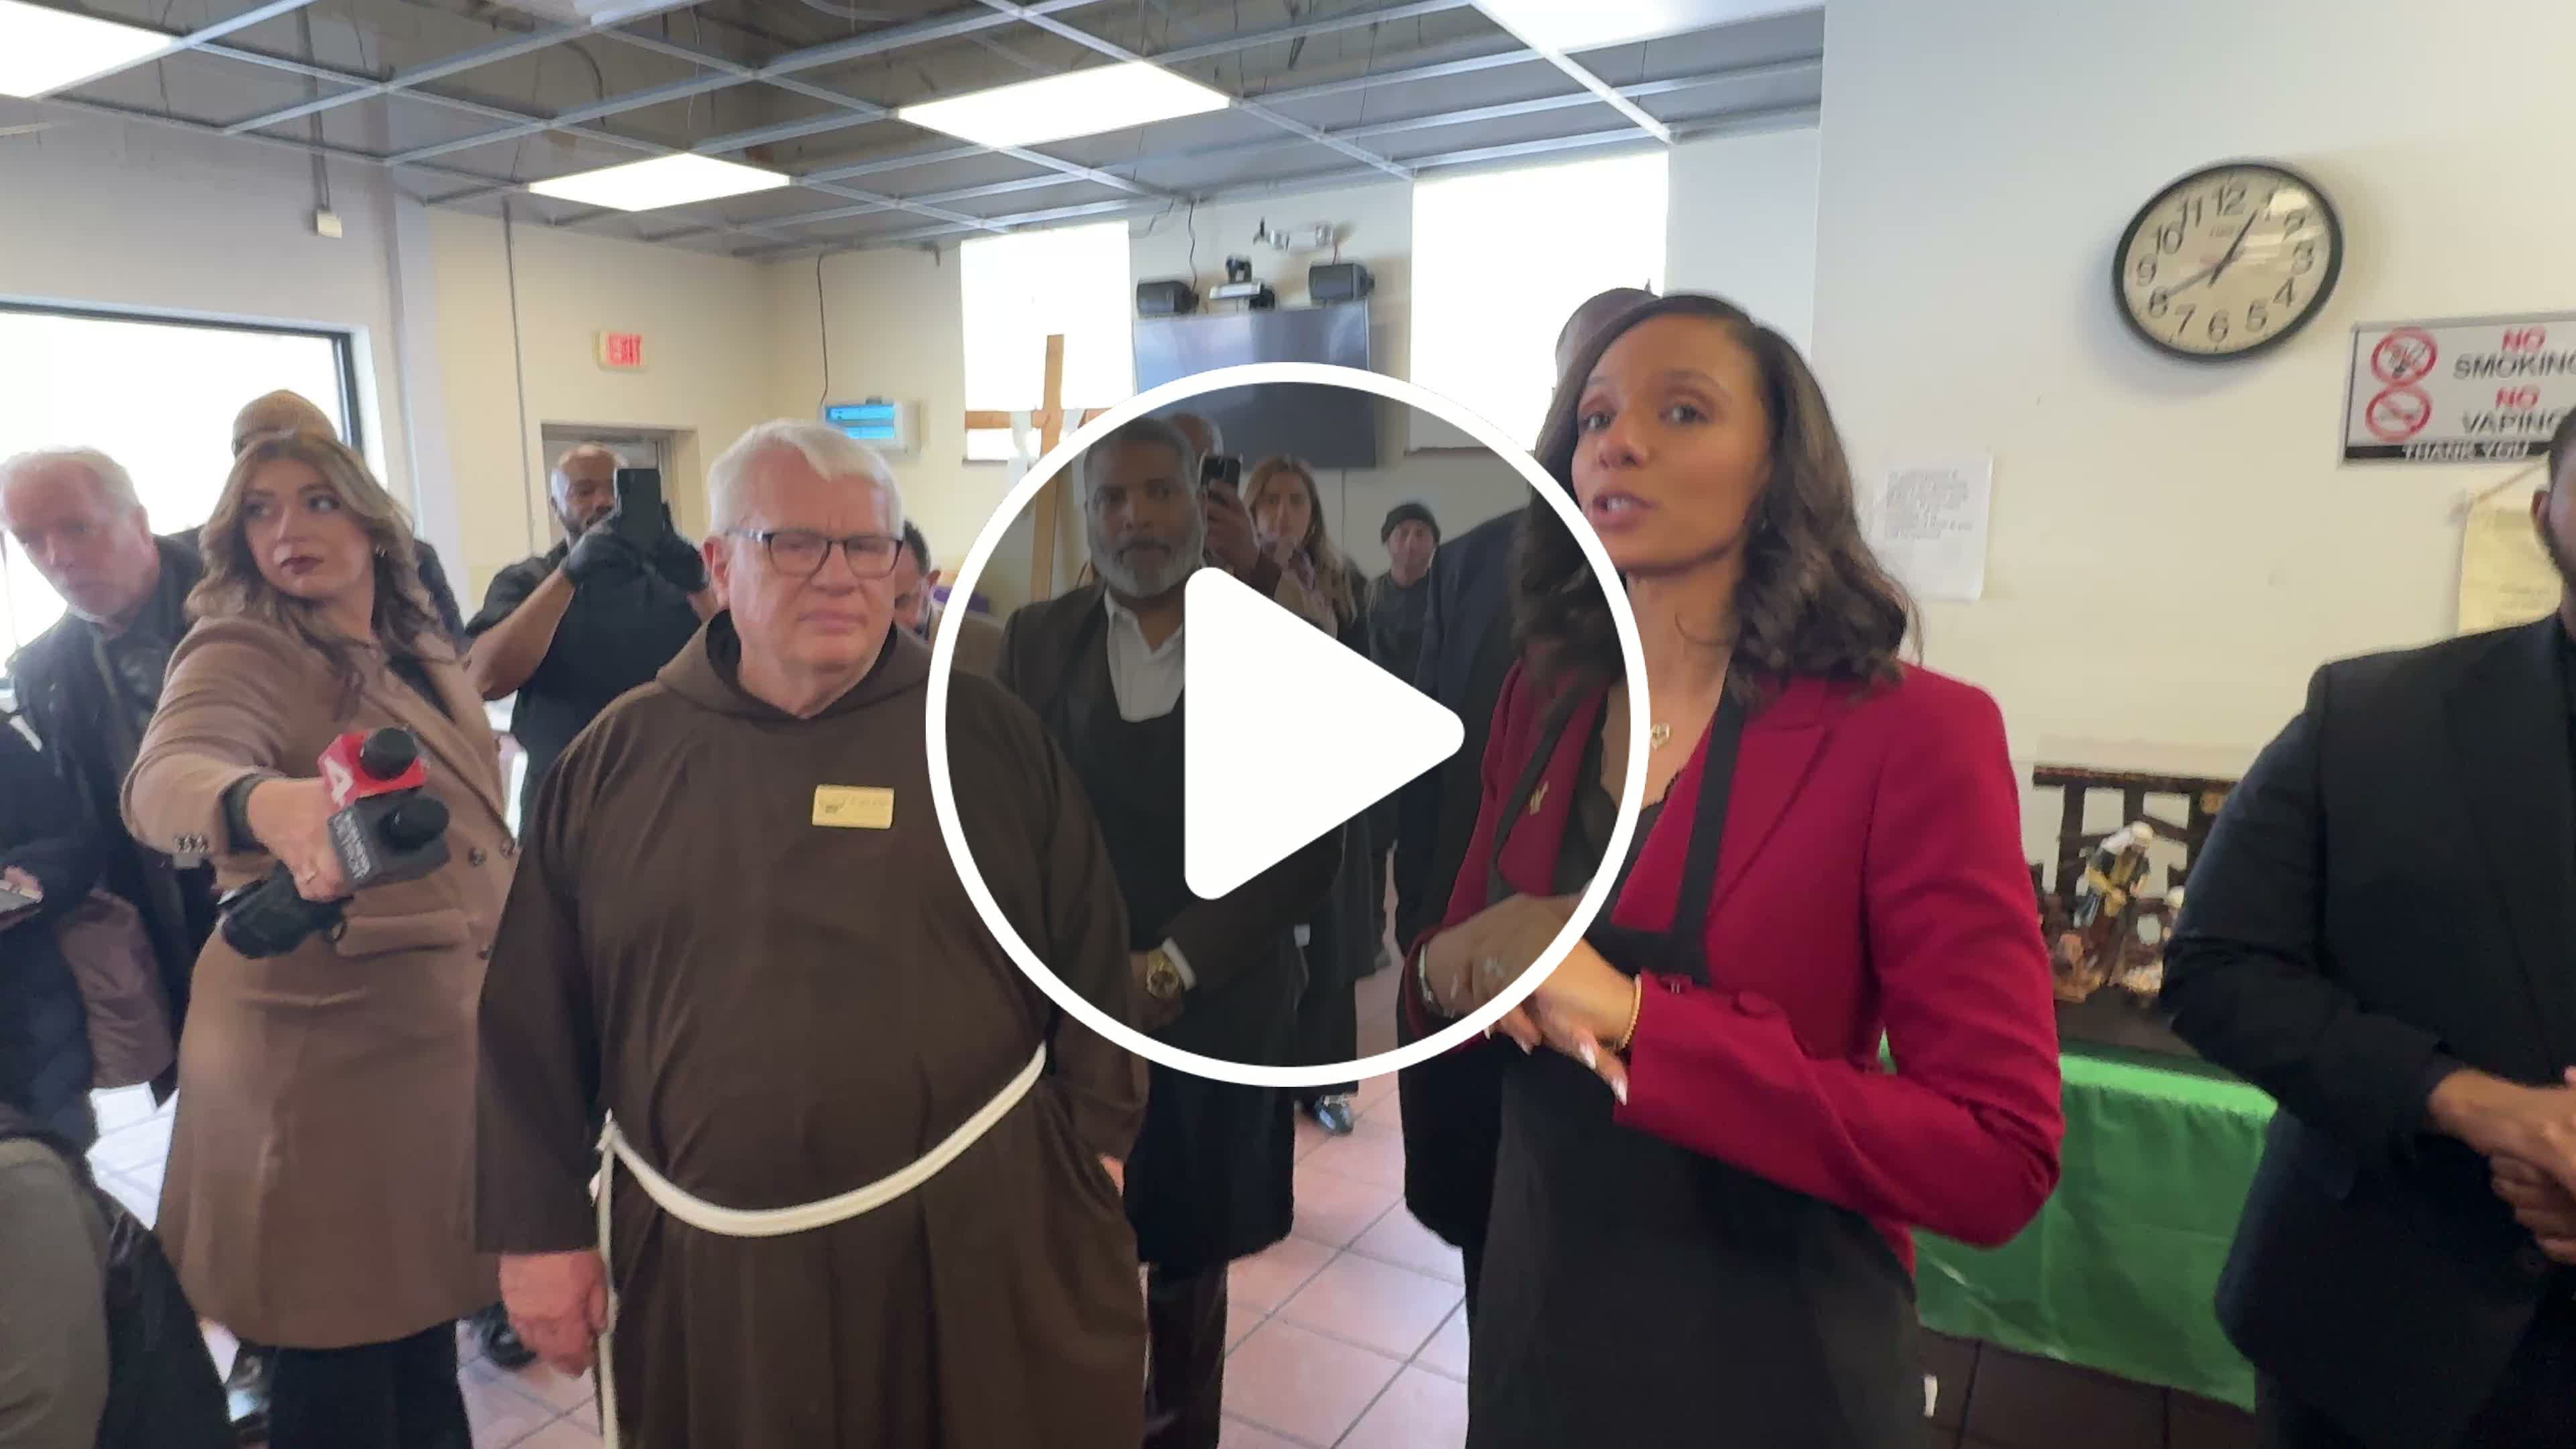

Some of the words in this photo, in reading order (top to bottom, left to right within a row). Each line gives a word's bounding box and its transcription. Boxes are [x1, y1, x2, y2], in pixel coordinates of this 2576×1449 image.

[2178, 197, 2203, 228] 11
[2213, 182, 2247, 216] 12
[2155, 221, 2184, 255] 10
[2282, 210, 2307, 241] 2
[2136, 254, 2157, 286] 9
[2292, 239, 2314, 275] 3
[2148, 286, 2169, 319] 8
[2272, 276, 2295, 308] 4
[2174, 303, 2196, 337] 7
[2208, 310, 2230, 342] 6
[2245, 299, 2269, 332] 5
[606, 333, 642, 366] EXIT
[2502, 327, 2546, 352] NO
[2496, 385, 2540, 410] NO
[2402, 440, 2475, 461] THANK
[2482, 440, 2530, 461] YOU
